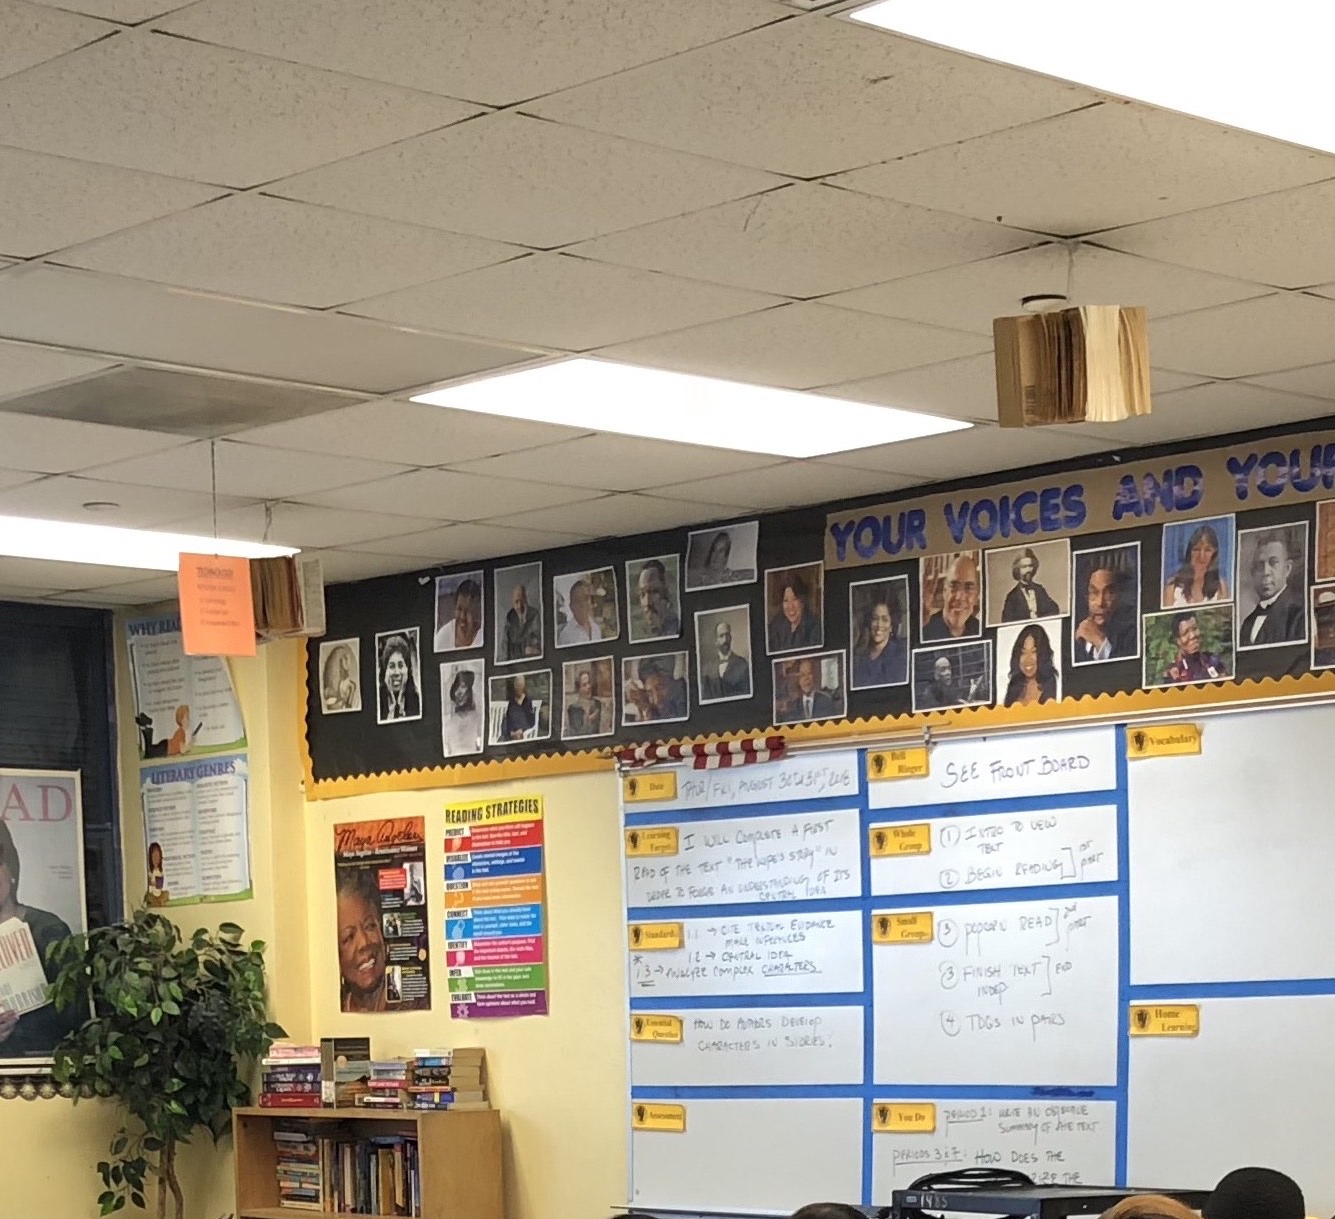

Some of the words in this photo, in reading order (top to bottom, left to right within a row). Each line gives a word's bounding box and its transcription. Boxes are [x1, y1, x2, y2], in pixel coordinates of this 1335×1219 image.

[829, 507, 927, 562] YOUR
[942, 484, 1087, 546] VOICES
[1111, 464, 1204, 522] AND
[128, 621, 157, 637] WHY
[1150, 734, 1197, 746] Vocabulary
[151, 766, 195, 785] LITERARY
[196, 760, 236, 777] GENRES
[898, 764, 923, 774] Ringer
[940, 761, 980, 788] SEE
[988, 759, 1036, 783] FRONT
[1037, 754, 1091, 777] BOARD
[445, 807, 483, 823] READING
[487, 798, 539, 819] STRATEGIES
[900, 931, 929, 940] Group
[1154, 1009, 1180, 1018] Home
[1161, 1022, 1197, 1033] Learning
